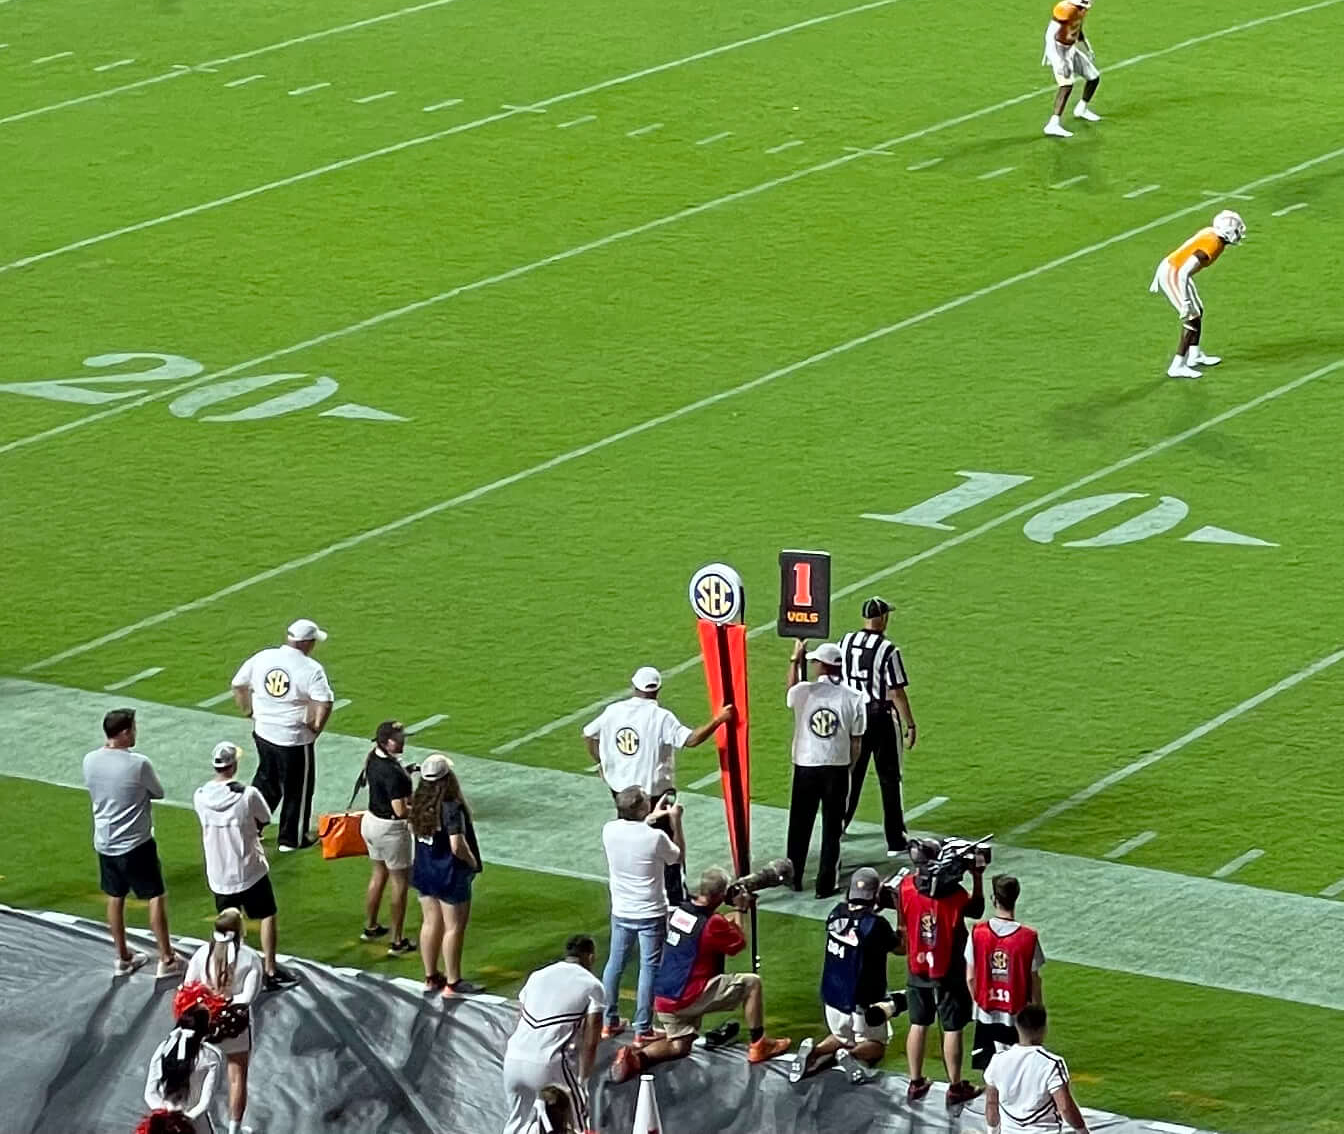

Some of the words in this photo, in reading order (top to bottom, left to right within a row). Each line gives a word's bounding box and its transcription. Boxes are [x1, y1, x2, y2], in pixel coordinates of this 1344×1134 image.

[0, 352, 338, 422] 20
[860, 471, 1189, 547] 10
[695, 574, 734, 617] SEC
[793, 563, 812, 606] 1
[787, 611, 818, 623] VOLS
[265, 669, 289, 697] SEC
[617, 727, 639, 754] SEC
[811, 710, 838, 737] SEC
